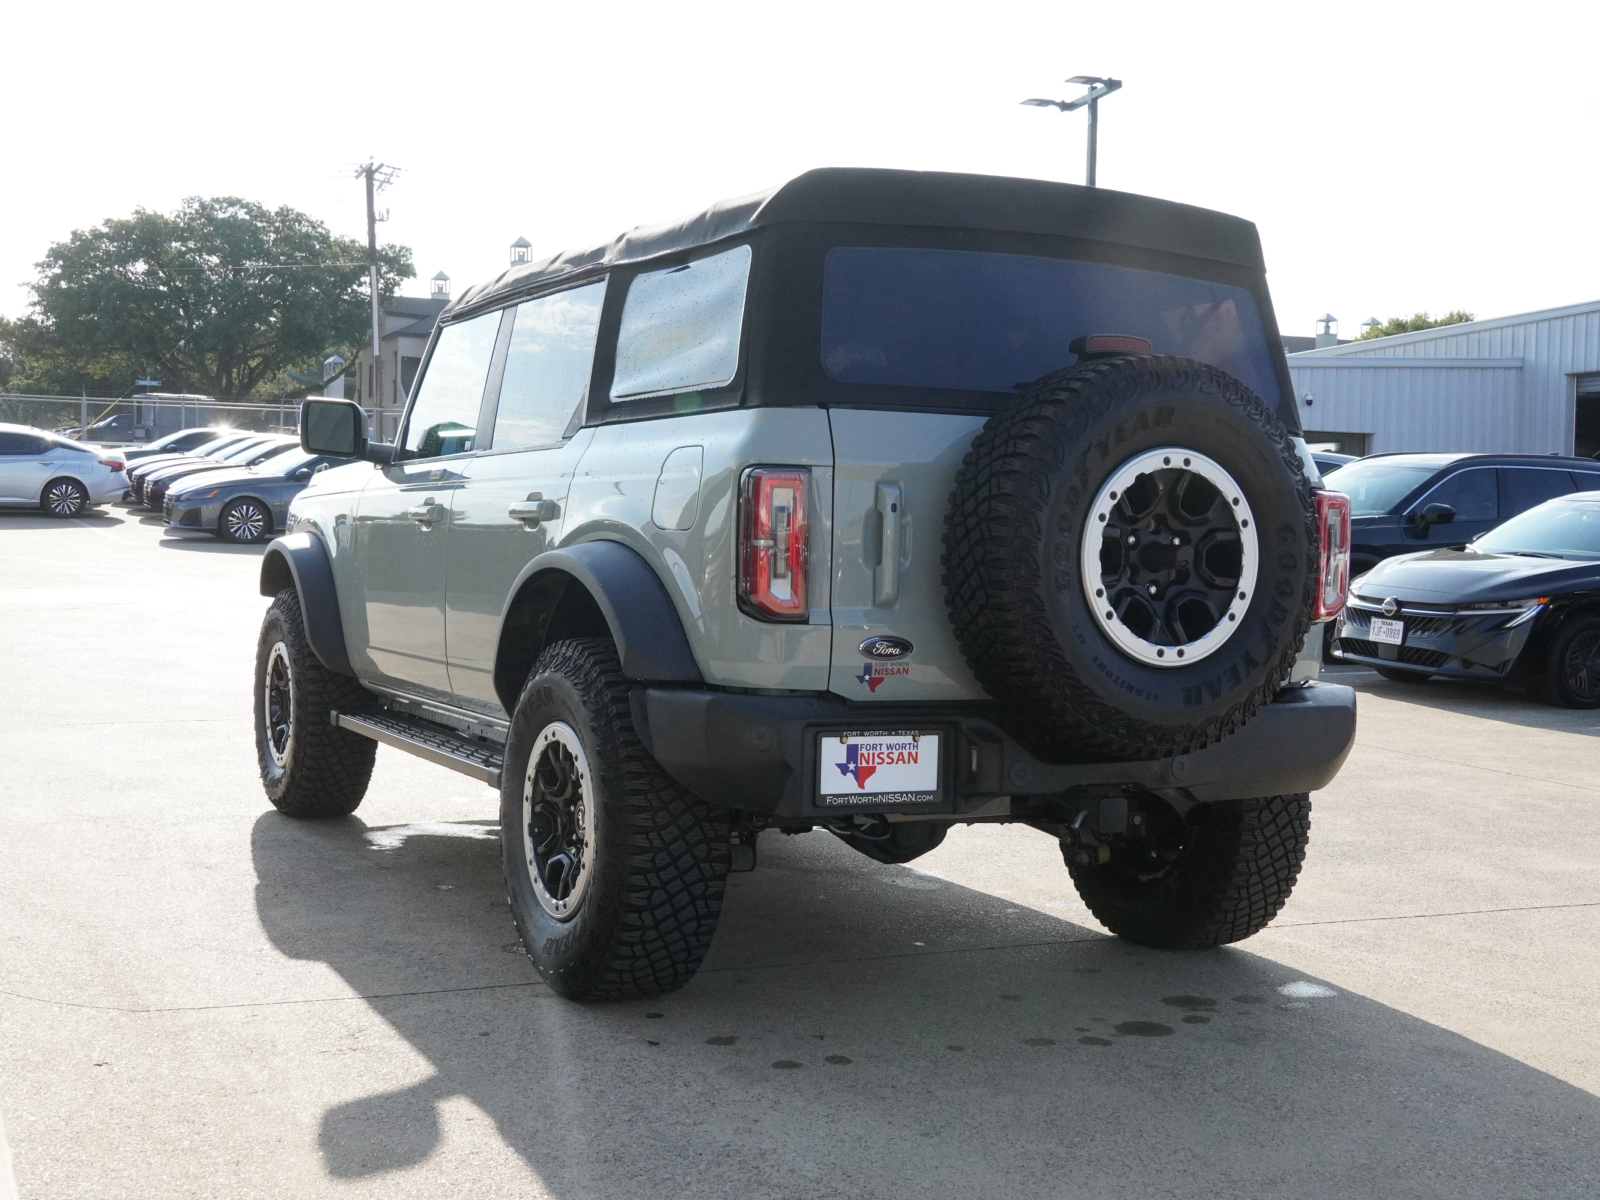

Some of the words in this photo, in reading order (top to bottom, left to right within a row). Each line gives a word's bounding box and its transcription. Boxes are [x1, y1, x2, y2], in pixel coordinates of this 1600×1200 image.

[872, 641, 902, 655] Ford
[874, 667, 909, 676] NISSAN
[1090, 655, 1159, 702] TERRITORY
[860, 743, 883, 752] FORT
[886, 742, 919, 751] WORTH
[859, 751, 919, 766] NISSAN
